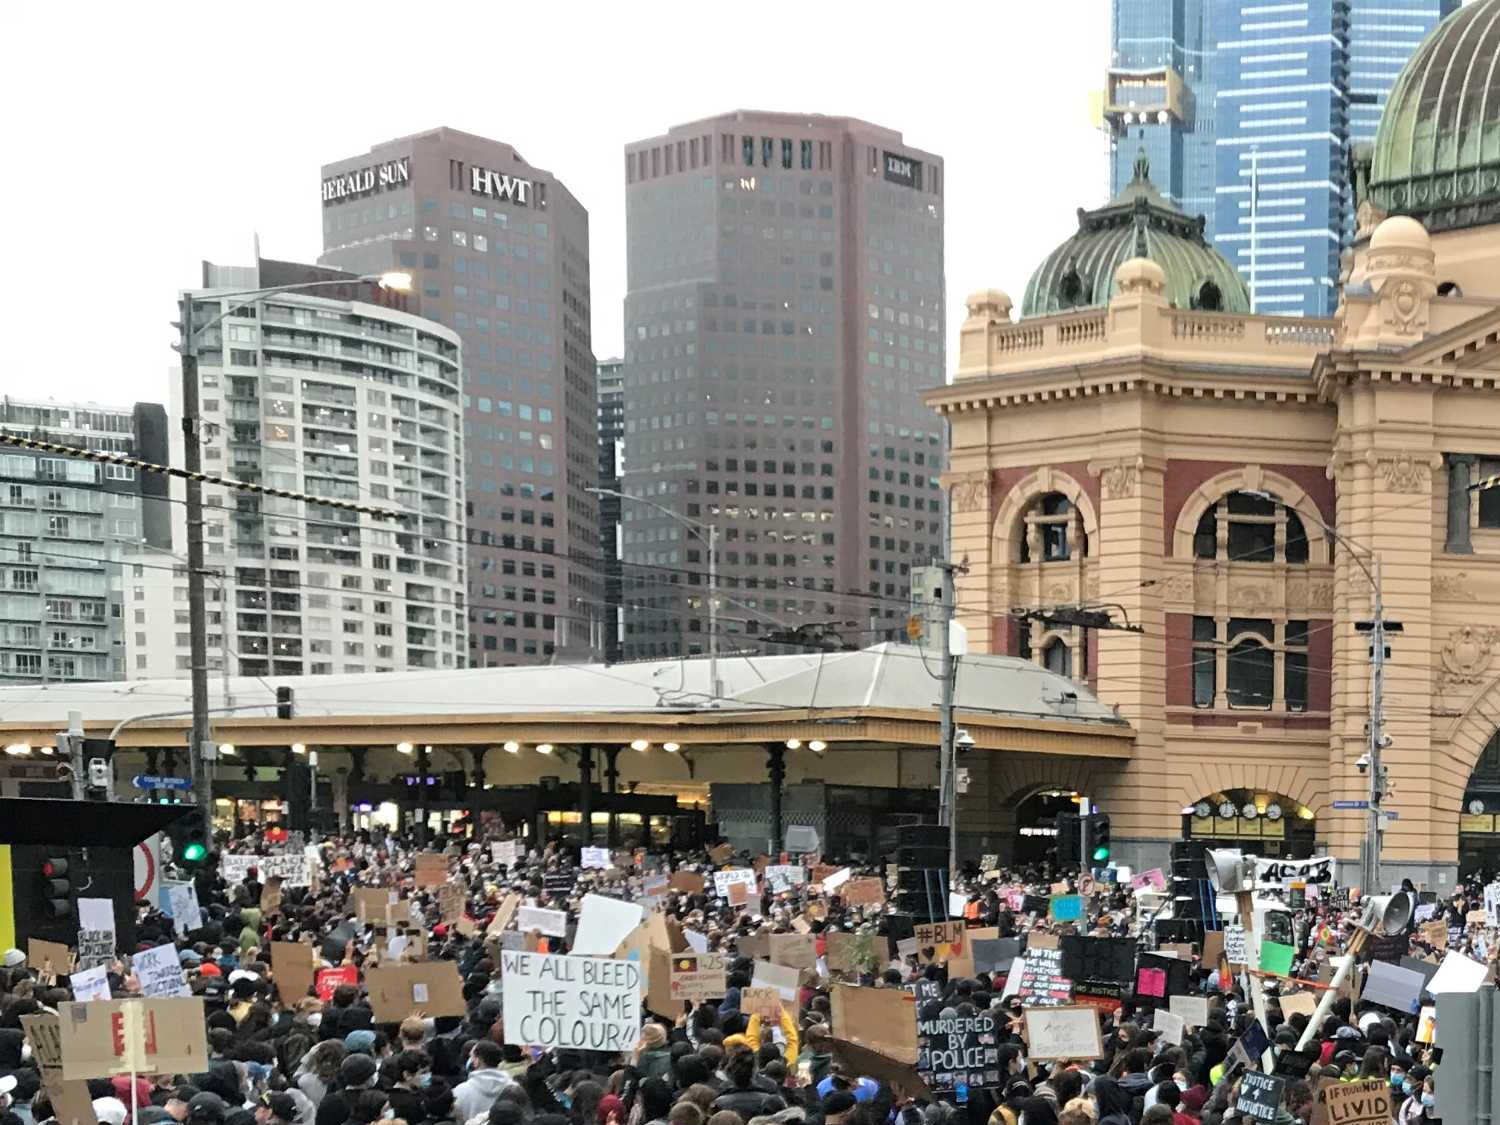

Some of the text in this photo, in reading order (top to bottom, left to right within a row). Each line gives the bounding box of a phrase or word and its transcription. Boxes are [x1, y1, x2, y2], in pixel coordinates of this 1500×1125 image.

[888, 157, 911, 178] IBM
[321, 160, 409, 201] HERALD SUN
[472, 168, 531, 203] HWT
[1261, 860, 1332, 884] ACAB
[917, 924, 963, 944] #BLM
[503, 954, 639, 989] WE ALL BLEED
[921, 983, 938, 997] ME
[526, 990, 633, 1020] THE SAME
[520, 1015, 637, 1050] COLOUR!!
[918, 1017, 994, 1035] MURDERED
[948, 1033, 967, 1050] BY
[931, 1047, 985, 1071] POLICE
[1243, 1073, 1275, 1091] JUSTICE
[1329, 1088, 1340, 1100] IF
[1362, 1079, 1384, 1093] NOT
[1236, 1099, 1275, 1120] INJUSTICE
[1330, 1097, 1388, 1121] LIVID
